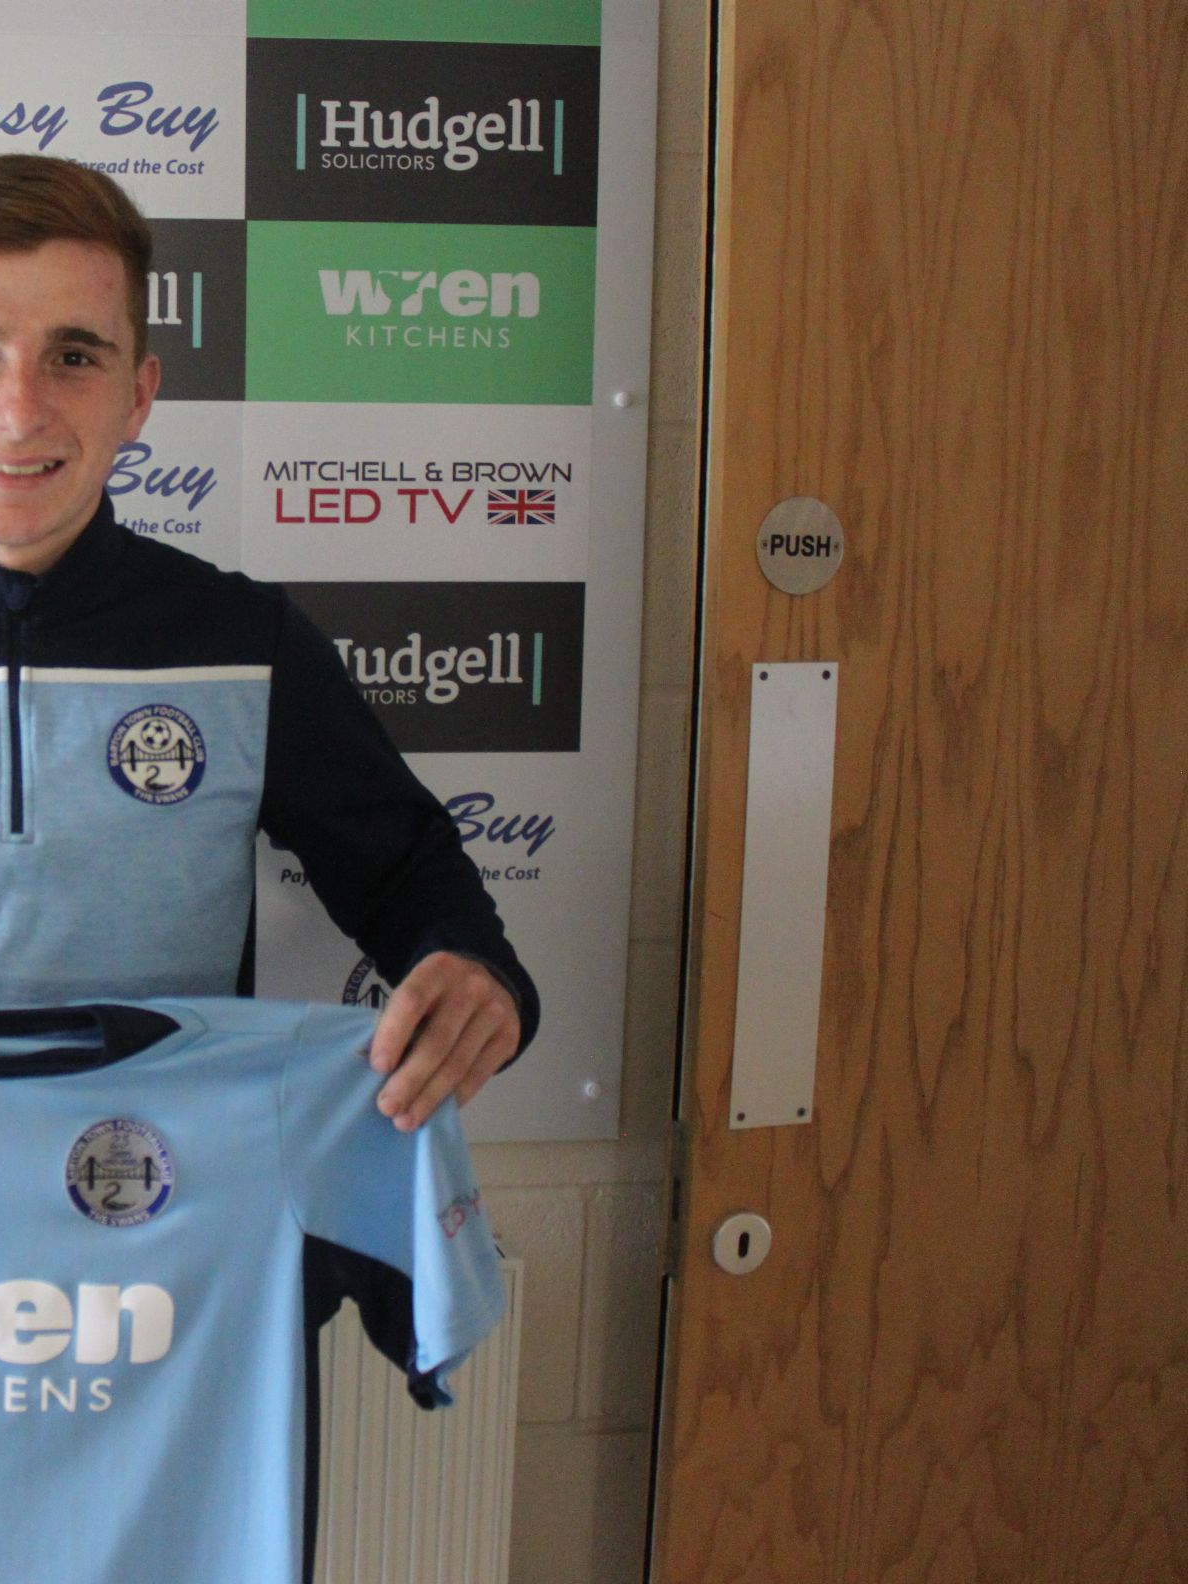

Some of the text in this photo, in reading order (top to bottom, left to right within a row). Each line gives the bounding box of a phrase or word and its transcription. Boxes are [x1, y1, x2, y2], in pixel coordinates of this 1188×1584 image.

[96, 81, 220, 152] Buy
[320, 97, 544, 171] Hudgell
[133, 157, 162, 174] the
[166, 159, 205, 175] Cost
[321, 153, 436, 171] SOLICITORS
[318, 270, 541, 318] wren
[345, 325, 511, 349] KITCHENS
[106, 442, 217, 512] Buy
[263, 461, 572, 484] MITCHELL & BROWN
[275, 488, 474, 524] LED TV
[132, 518, 159, 534] the
[163, 518, 202, 534] Cost
[770, 533, 831, 557] PUSH
[479, 866, 500, 880] he
[505, 866, 540, 881] Cost
